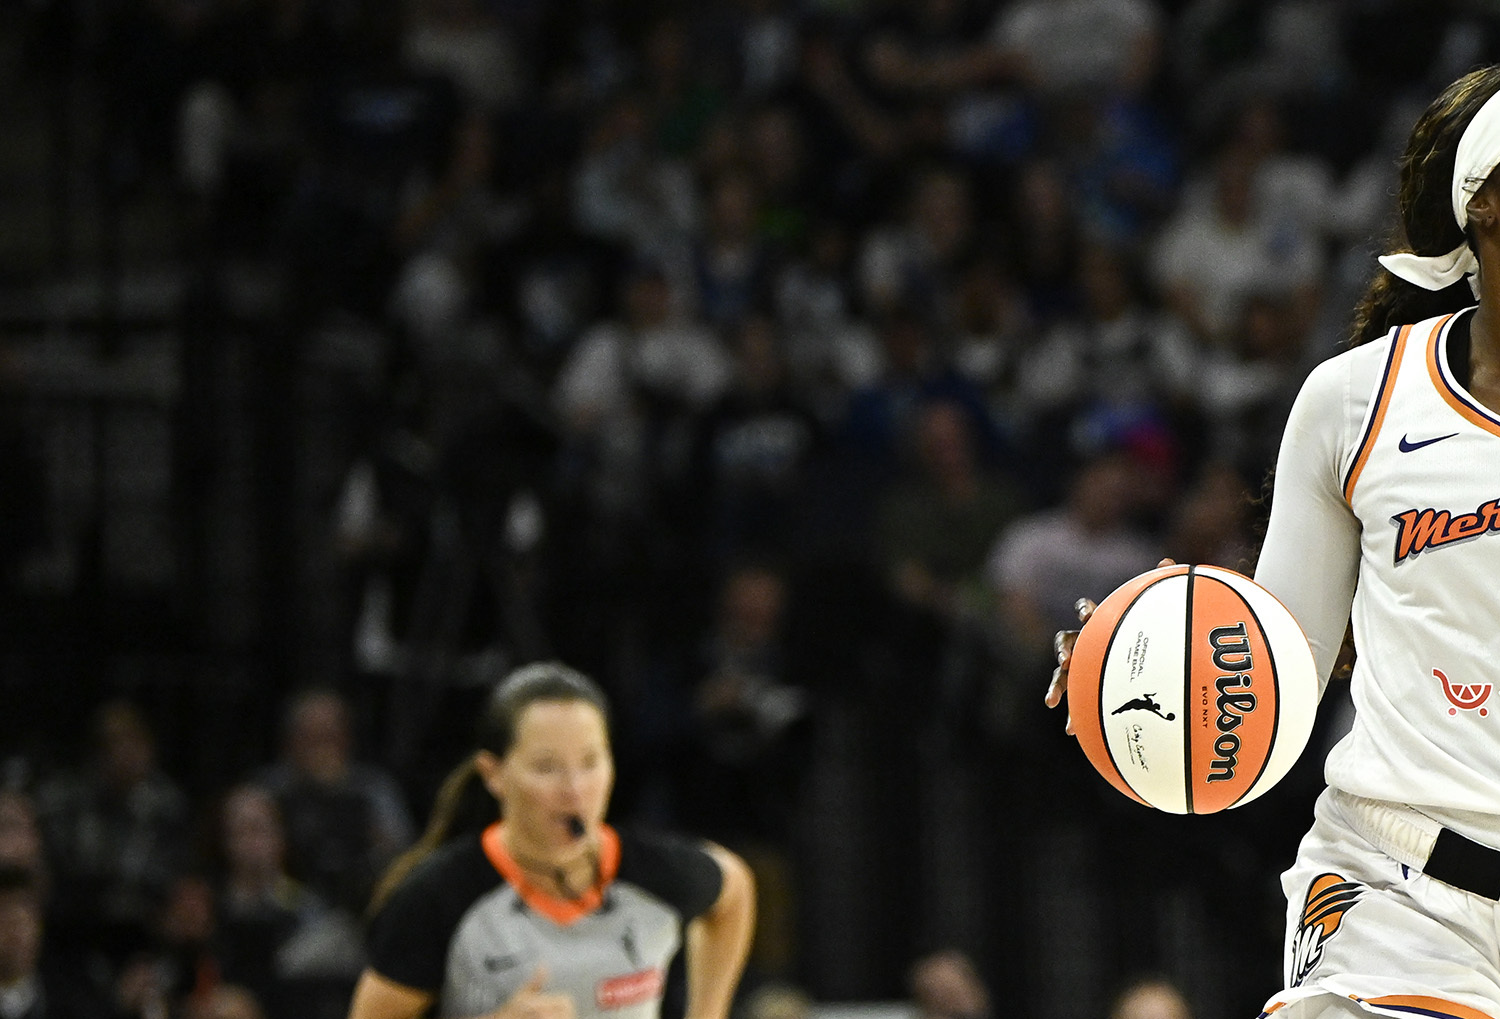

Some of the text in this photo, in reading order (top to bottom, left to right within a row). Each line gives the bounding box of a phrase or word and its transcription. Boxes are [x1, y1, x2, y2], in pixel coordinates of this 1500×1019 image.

[1130, 631, 1144, 682] GAME BALL
[1138, 637, 1149, 677] OFFICIAL
[1206, 621, 1258, 783] Wilson
